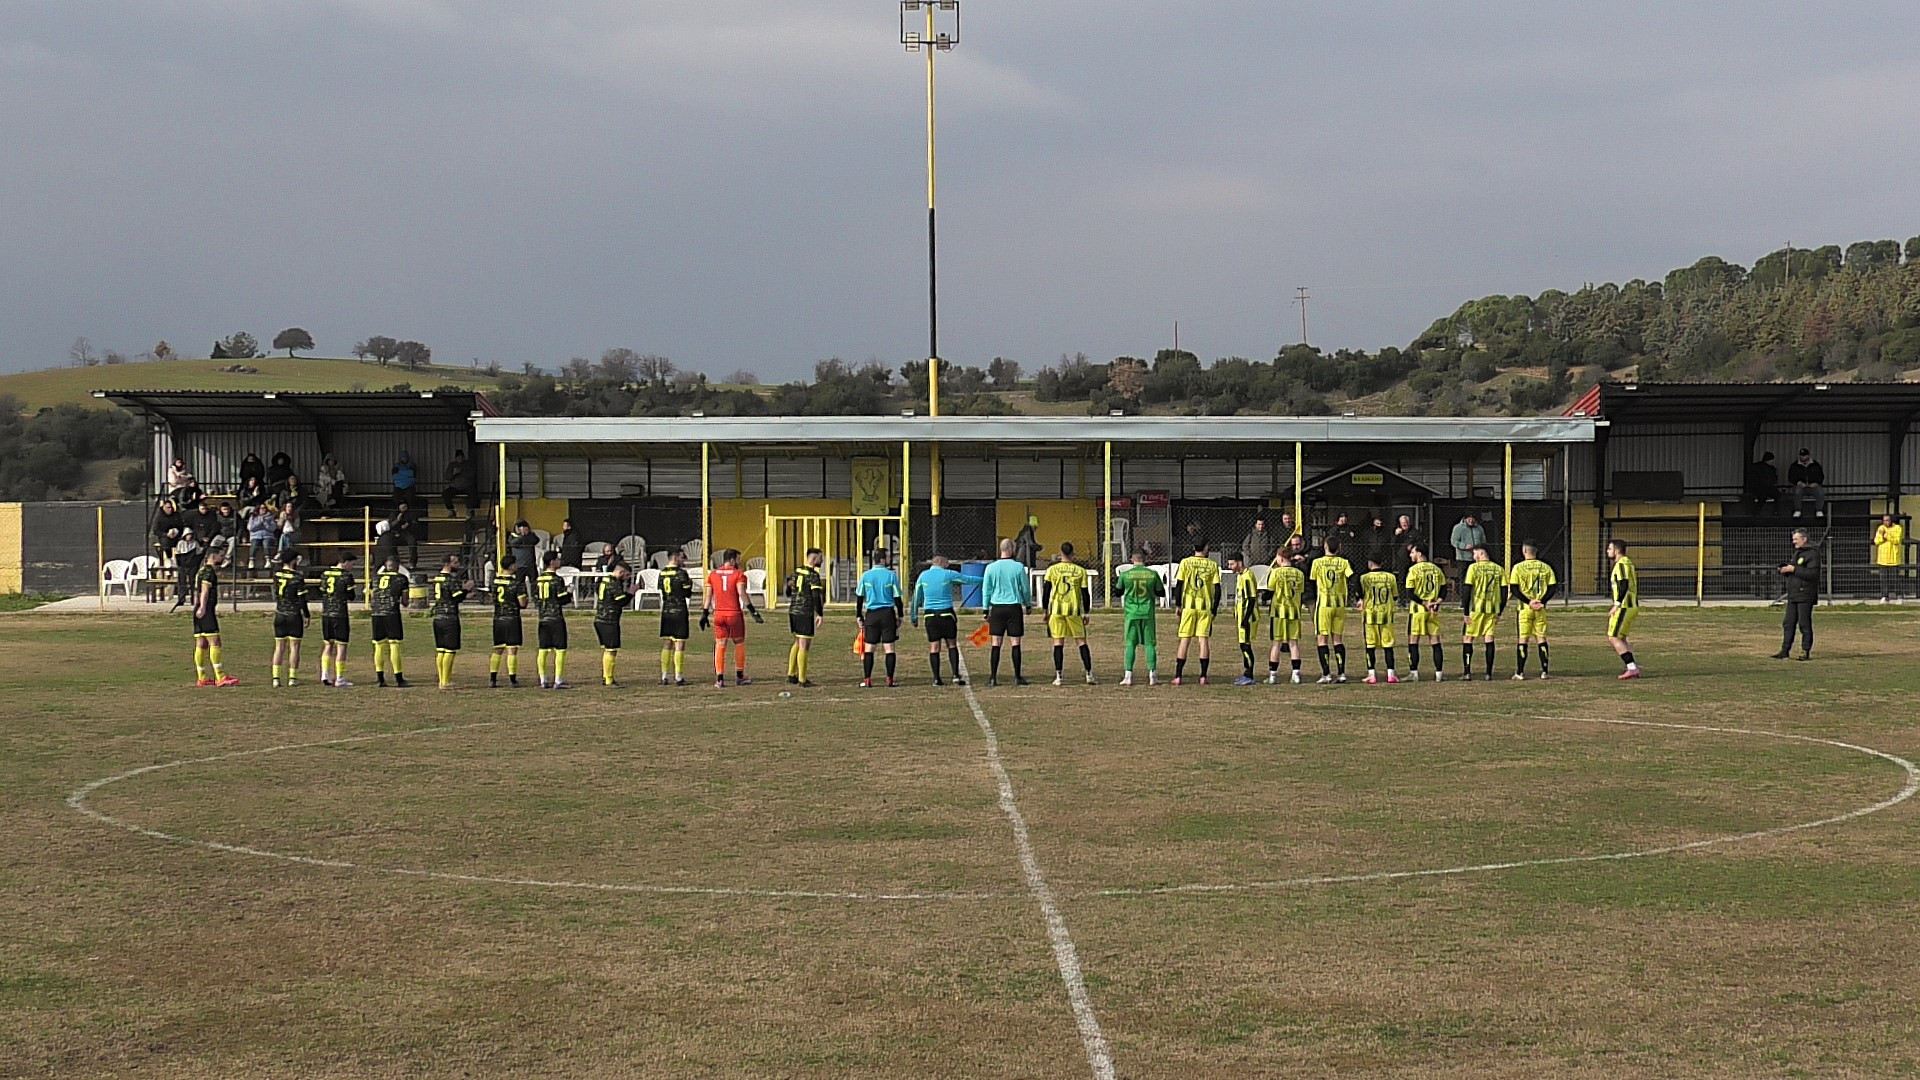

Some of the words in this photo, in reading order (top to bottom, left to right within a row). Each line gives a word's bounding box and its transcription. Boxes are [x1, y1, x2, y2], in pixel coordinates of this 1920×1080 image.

[327, 577, 335, 593] 3
[379, 576, 389, 589] 6
[722, 575, 728, 591] 1
[1326, 569, 1335, 588] 9
[1425, 574, 1434, 594] 8
[279, 579, 287, 595] 7
[497, 586, 505, 602] 2
[1059, 576, 1071, 598] 5
[1132, 580, 1147, 597] 15
[1373, 586, 1389, 604] 10
